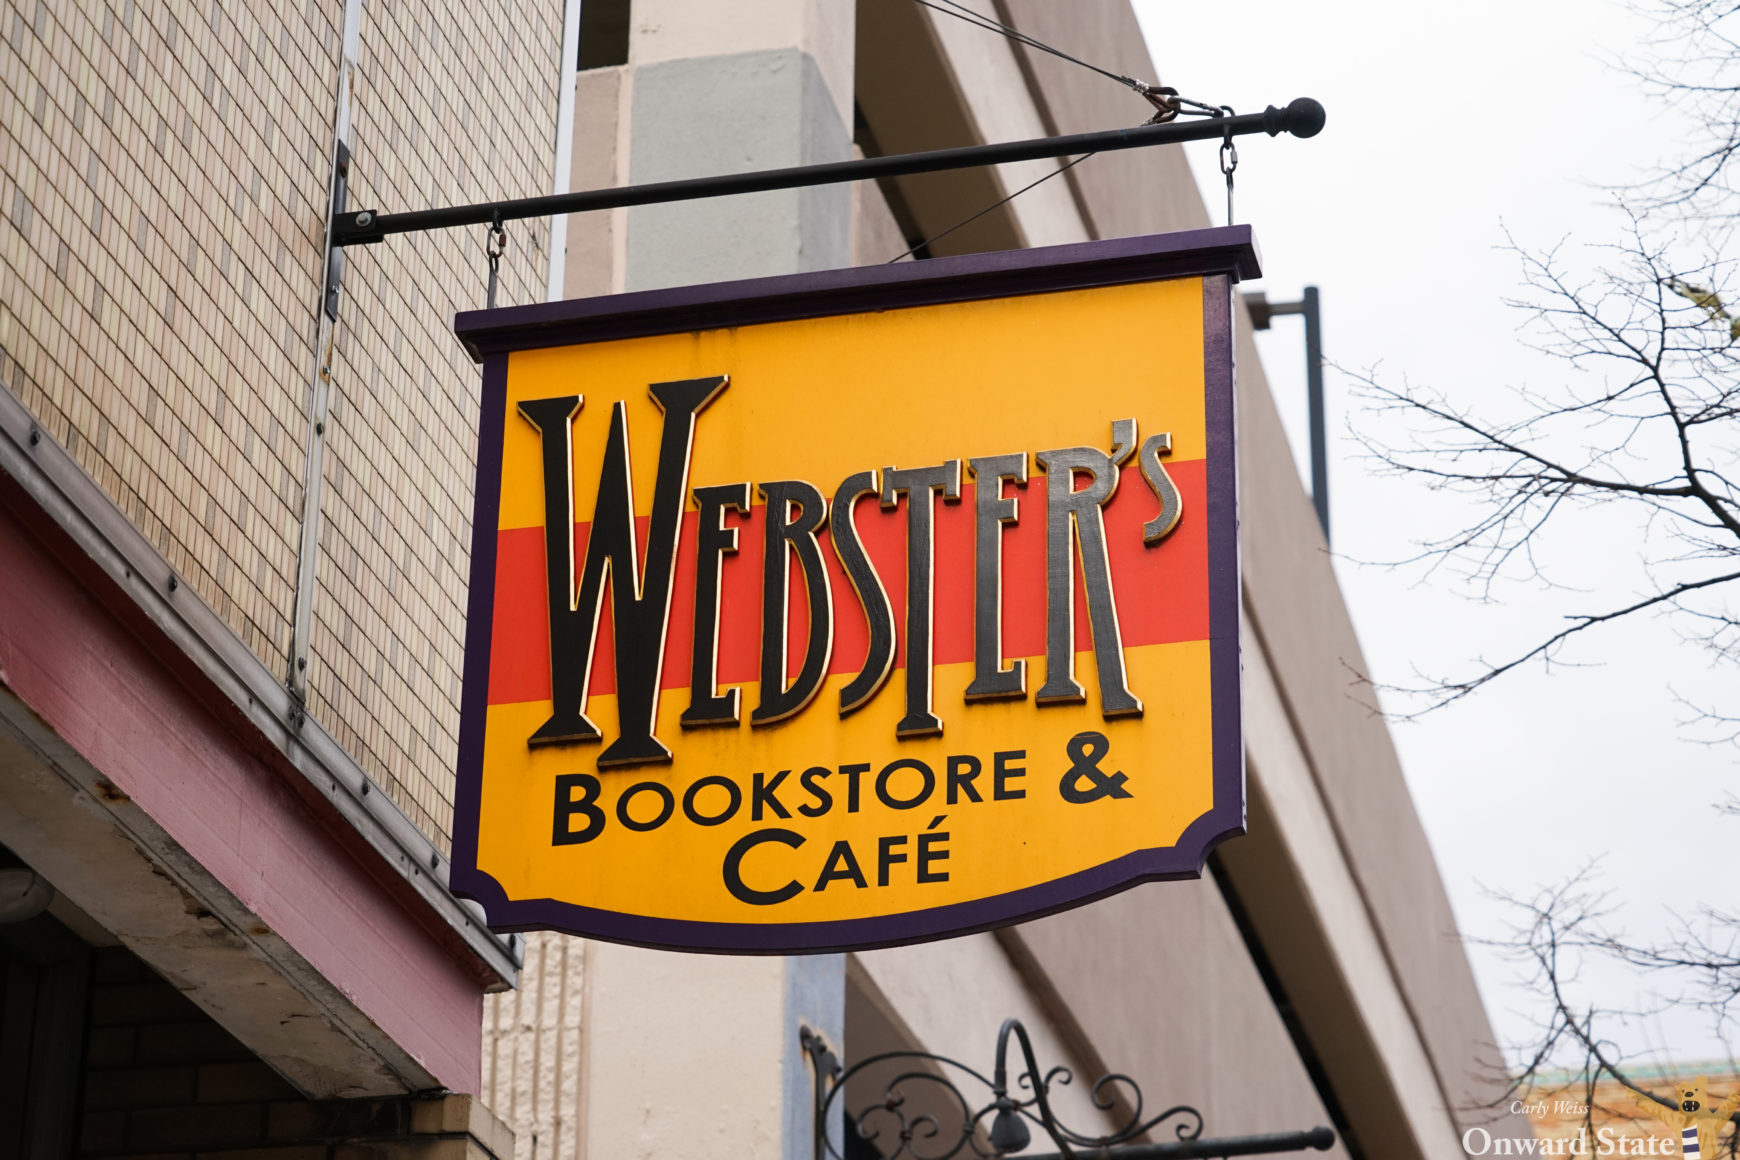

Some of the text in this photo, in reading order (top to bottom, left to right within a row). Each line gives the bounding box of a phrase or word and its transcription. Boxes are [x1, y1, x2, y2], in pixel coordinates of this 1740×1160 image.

[517, 374, 1183, 767] WEBSTER'S
[551, 731, 1134, 846] BOOKSTORE &
[722, 815, 951, 905] CAFÉ
